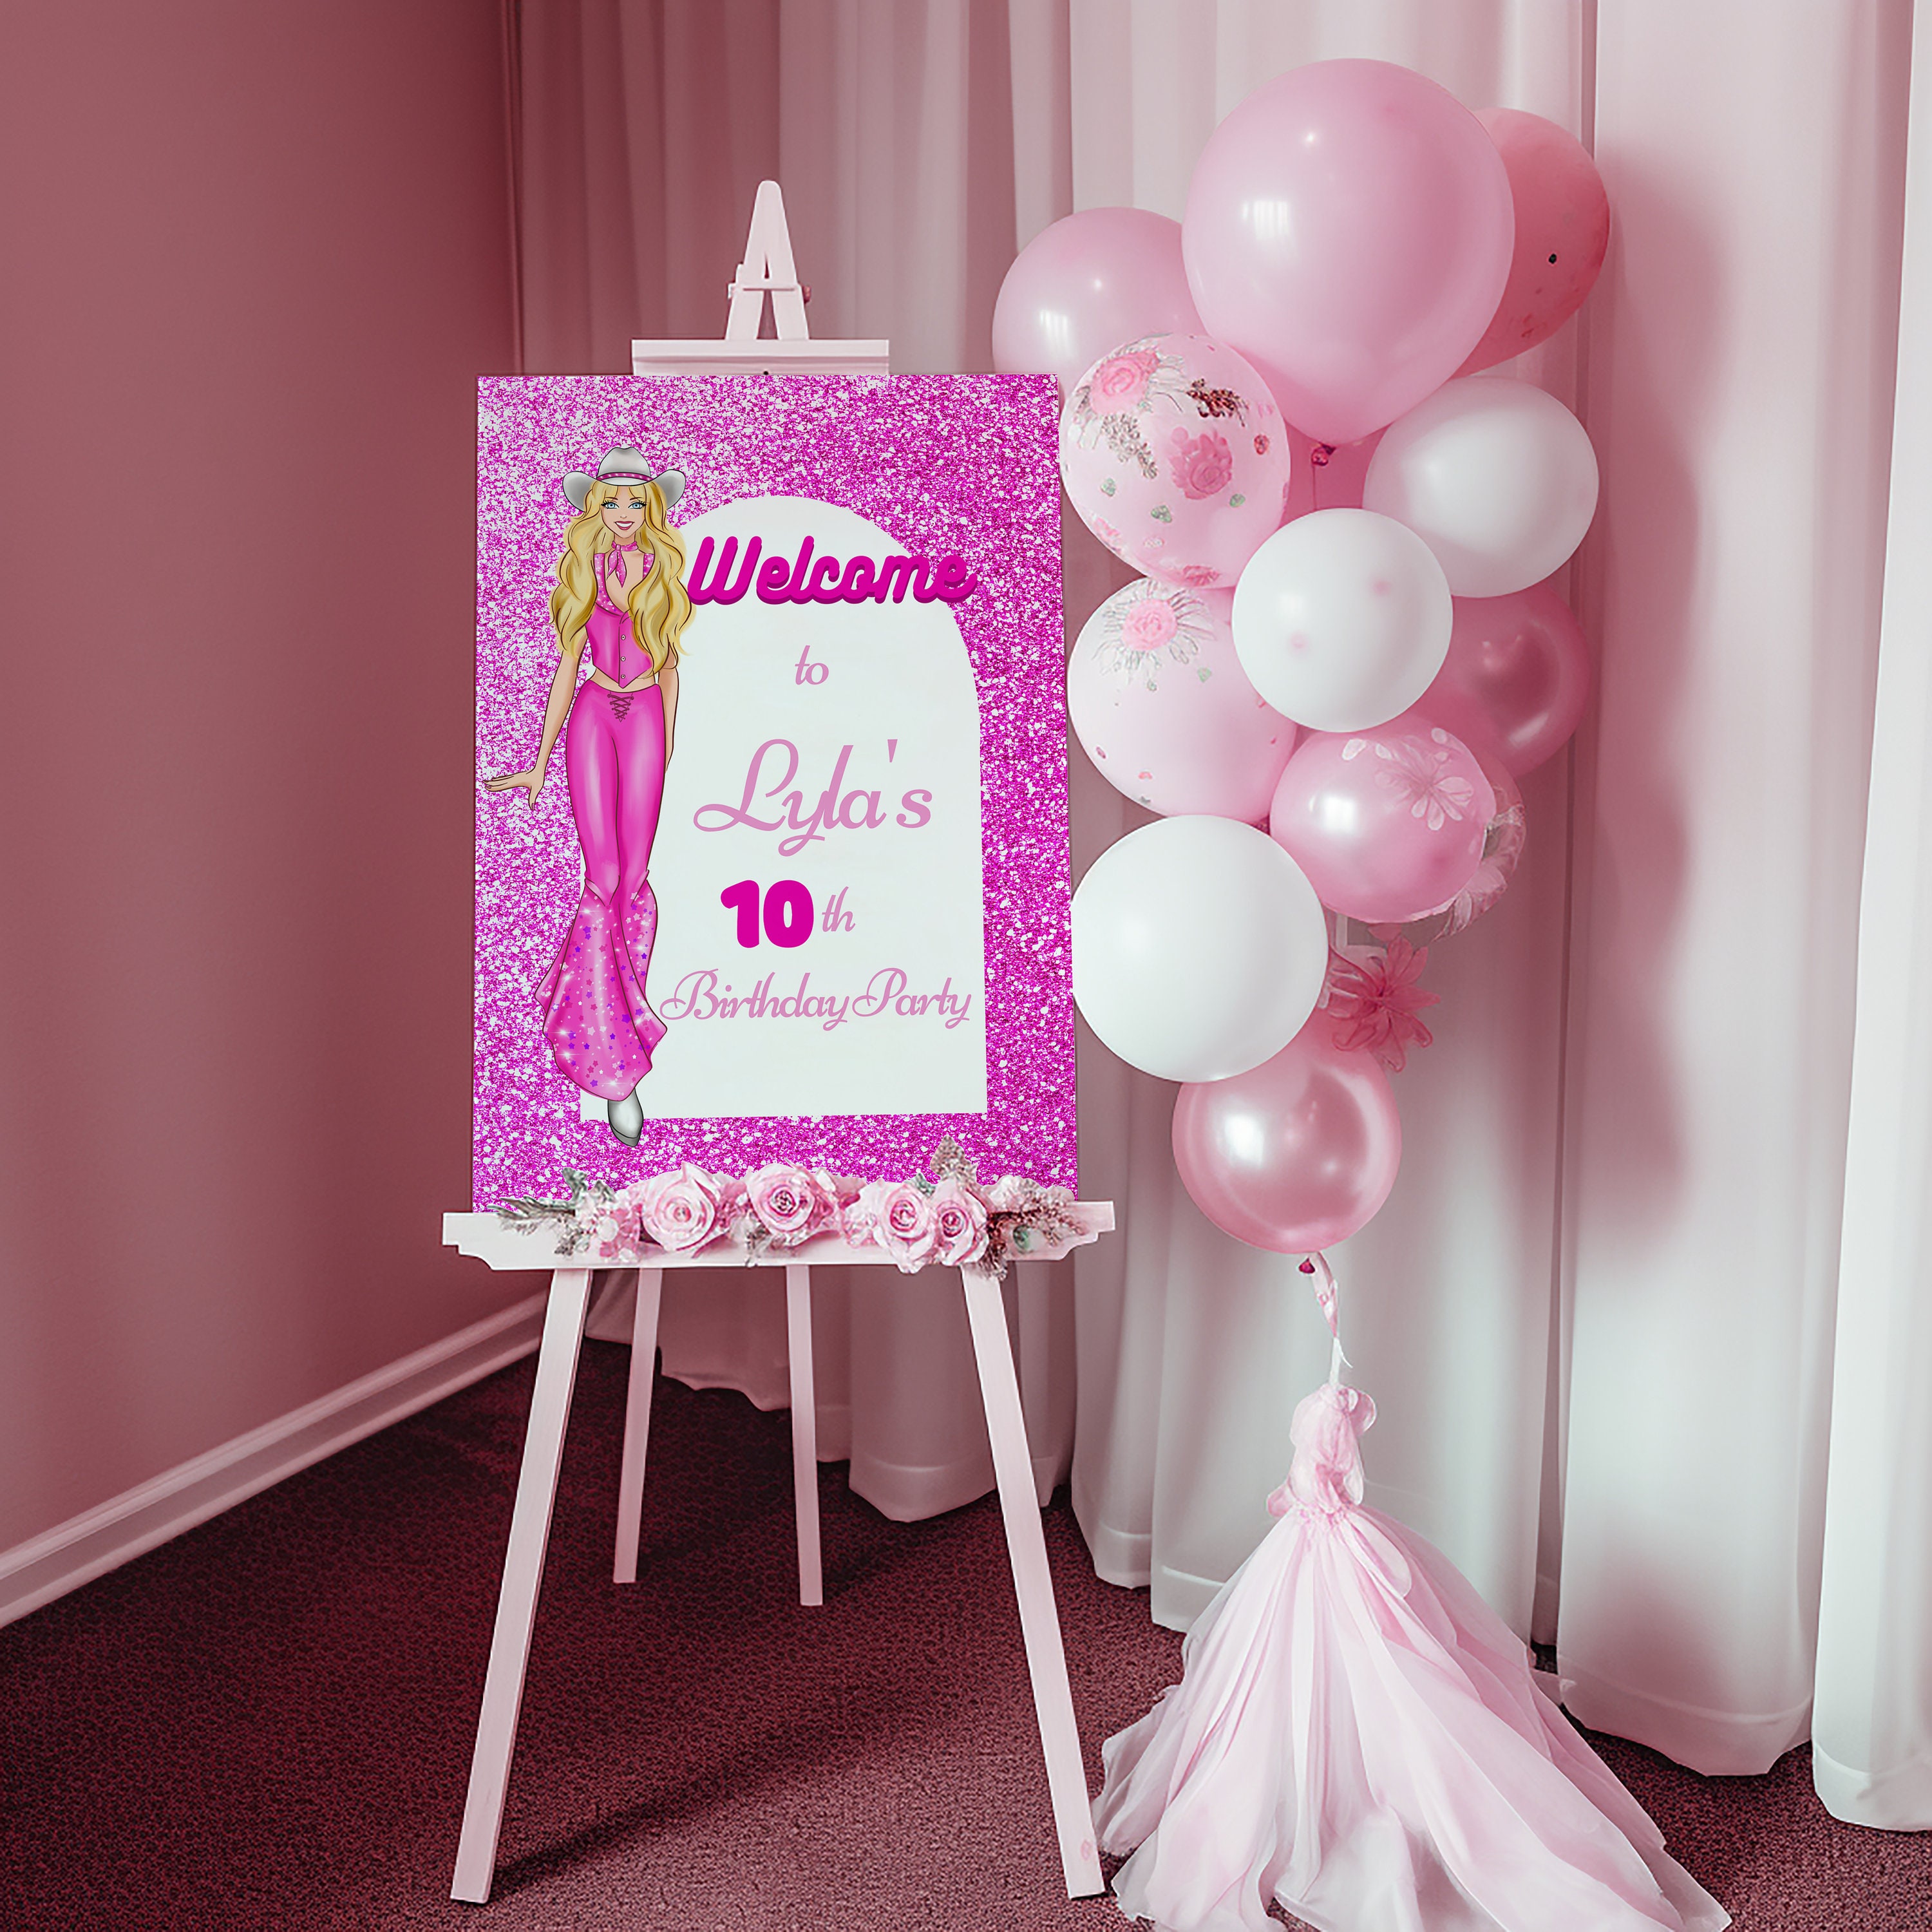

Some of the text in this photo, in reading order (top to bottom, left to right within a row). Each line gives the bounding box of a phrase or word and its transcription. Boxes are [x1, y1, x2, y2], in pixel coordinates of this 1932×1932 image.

[687, 535, 978, 605] Welcome
[795, 645, 829, 685] to
[693, 739, 933, 857] Lyla's
[659, 967, 972, 1031] Birthday Party
